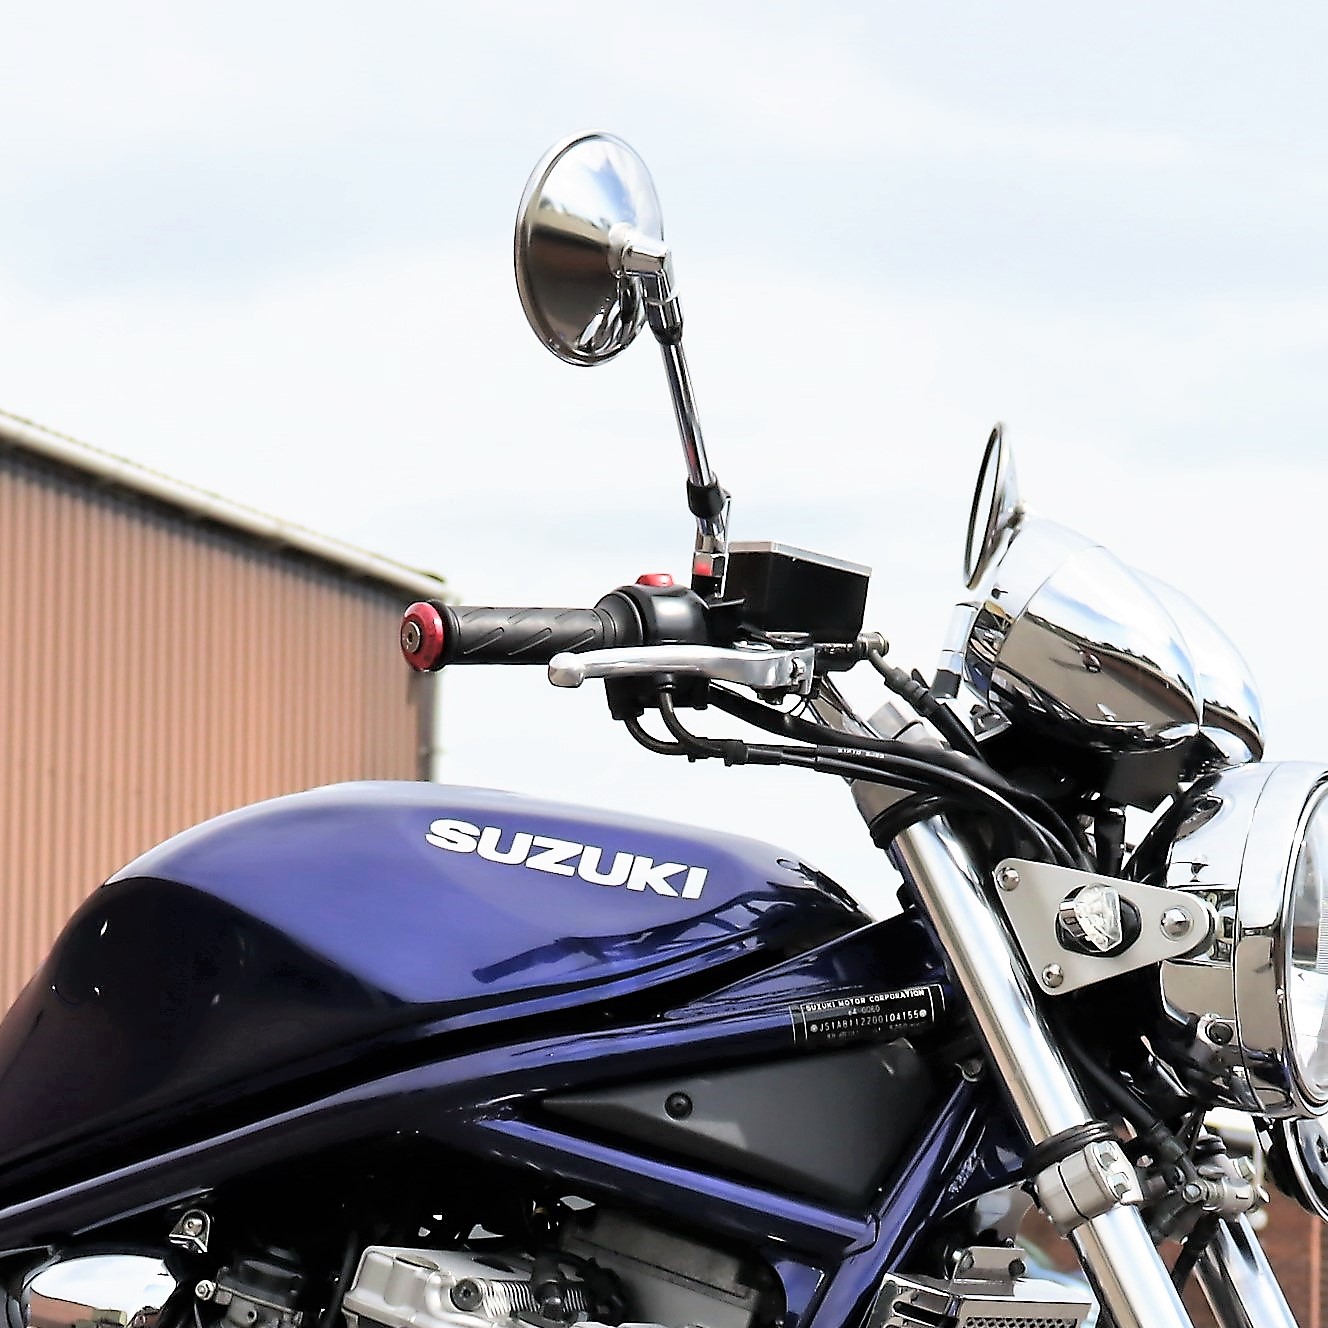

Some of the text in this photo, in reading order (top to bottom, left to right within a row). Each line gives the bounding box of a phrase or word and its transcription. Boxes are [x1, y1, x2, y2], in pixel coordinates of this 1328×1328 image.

[425, 818, 708, 899] SUZUKI
[838, 996, 866, 1008] MOTOR
[869, 989, 925, 1003] CORPORATION
